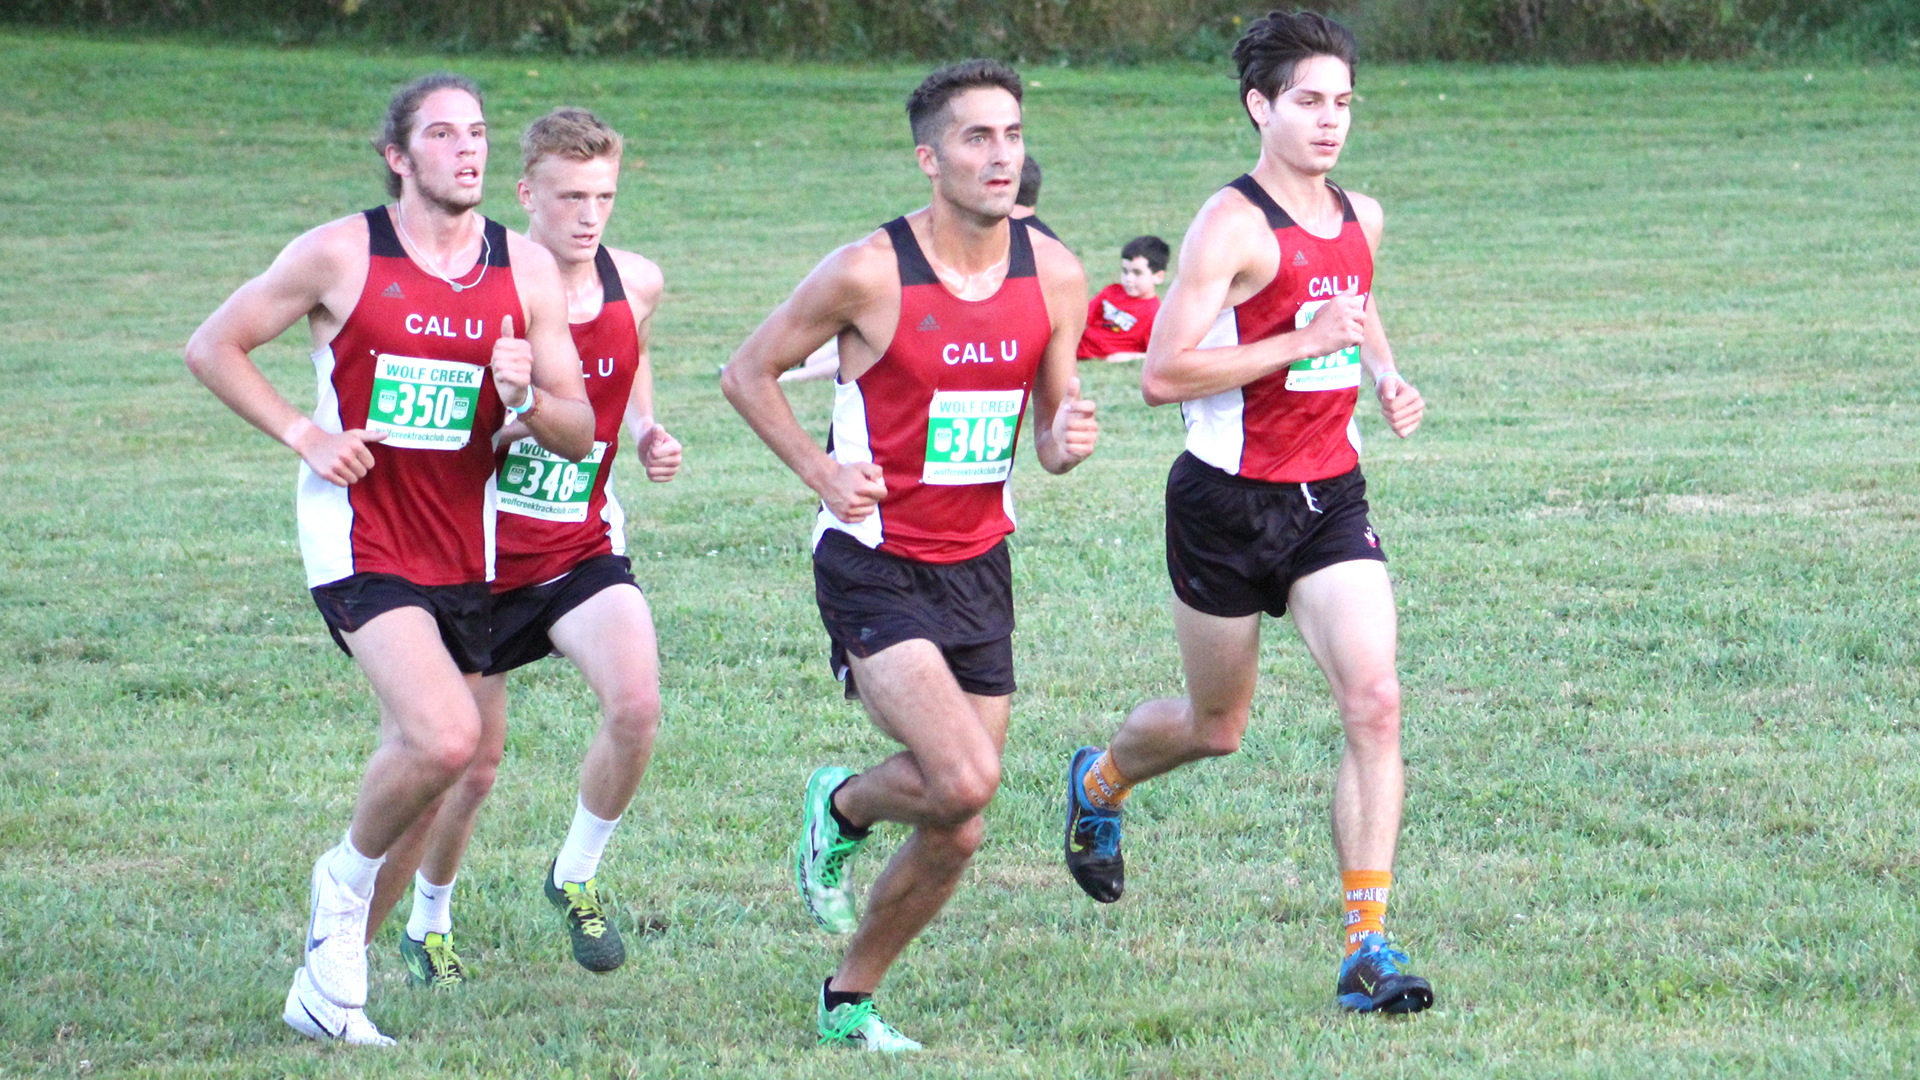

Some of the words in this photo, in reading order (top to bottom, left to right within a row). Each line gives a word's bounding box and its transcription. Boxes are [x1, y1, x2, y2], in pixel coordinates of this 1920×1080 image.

[1309, 276, 1343, 297] CAL
[1347, 275, 1358, 289] U
[405, 313, 457, 337] CAL
[465, 318, 483, 339] U
[942, 342, 994, 365] CAL
[1000, 339, 1018, 361] U
[386, 363, 426, 380] WOLF
[430, 368, 475, 384] CREEK
[598, 357, 614, 377] U
[393, 383, 455, 428] 350
[940, 401, 976, 414] WOLF
[980, 400, 1017, 414] CREEK
[950, 418, 1005, 462] 349
[520, 460, 578, 502] 348
[500, 496, 580, 514] wolfcreektrackclub.com
[799, 853, 828, 925] BROOKS
[1346, 887, 1389, 903] WHEATIES
